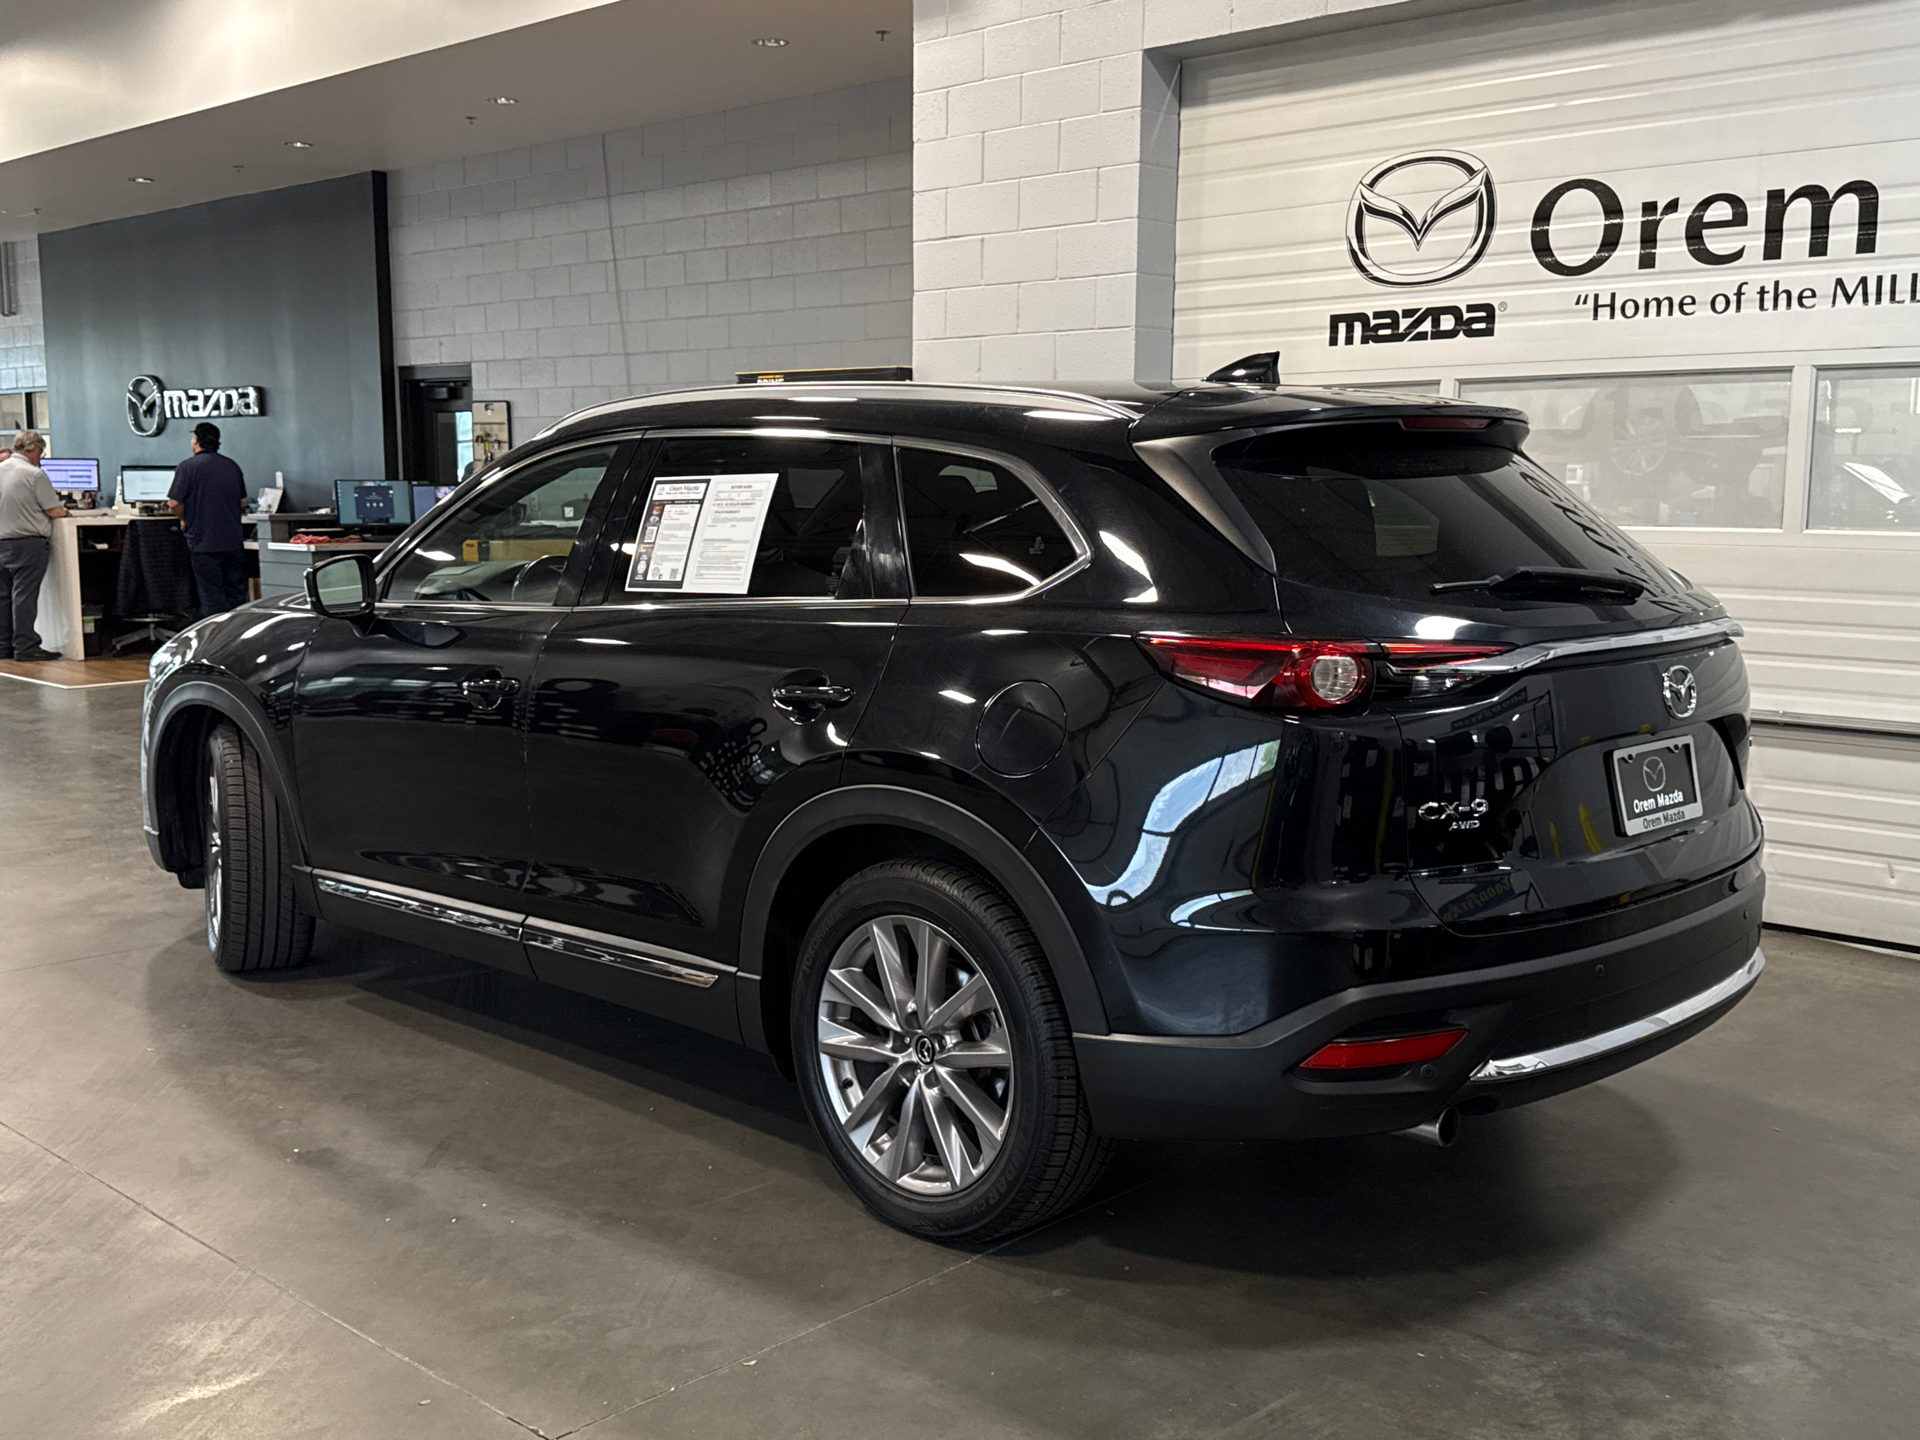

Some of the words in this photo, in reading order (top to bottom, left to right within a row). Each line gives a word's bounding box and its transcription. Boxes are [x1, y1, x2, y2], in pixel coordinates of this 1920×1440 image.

[1529, 177, 1880, 277] Orem
[1709, 281, 1748, 315] of
[1756, 279, 1817, 311] the
[1418, 798, 1489, 820] CX-9
[1633, 798, 1656, 814] Orem
[1656, 789, 1684, 808] Mazda
[1448, 820, 1481, 832] AWD
[1642, 817, 1662, 830] Orem
[1661, 809, 1686, 824] Mazda
